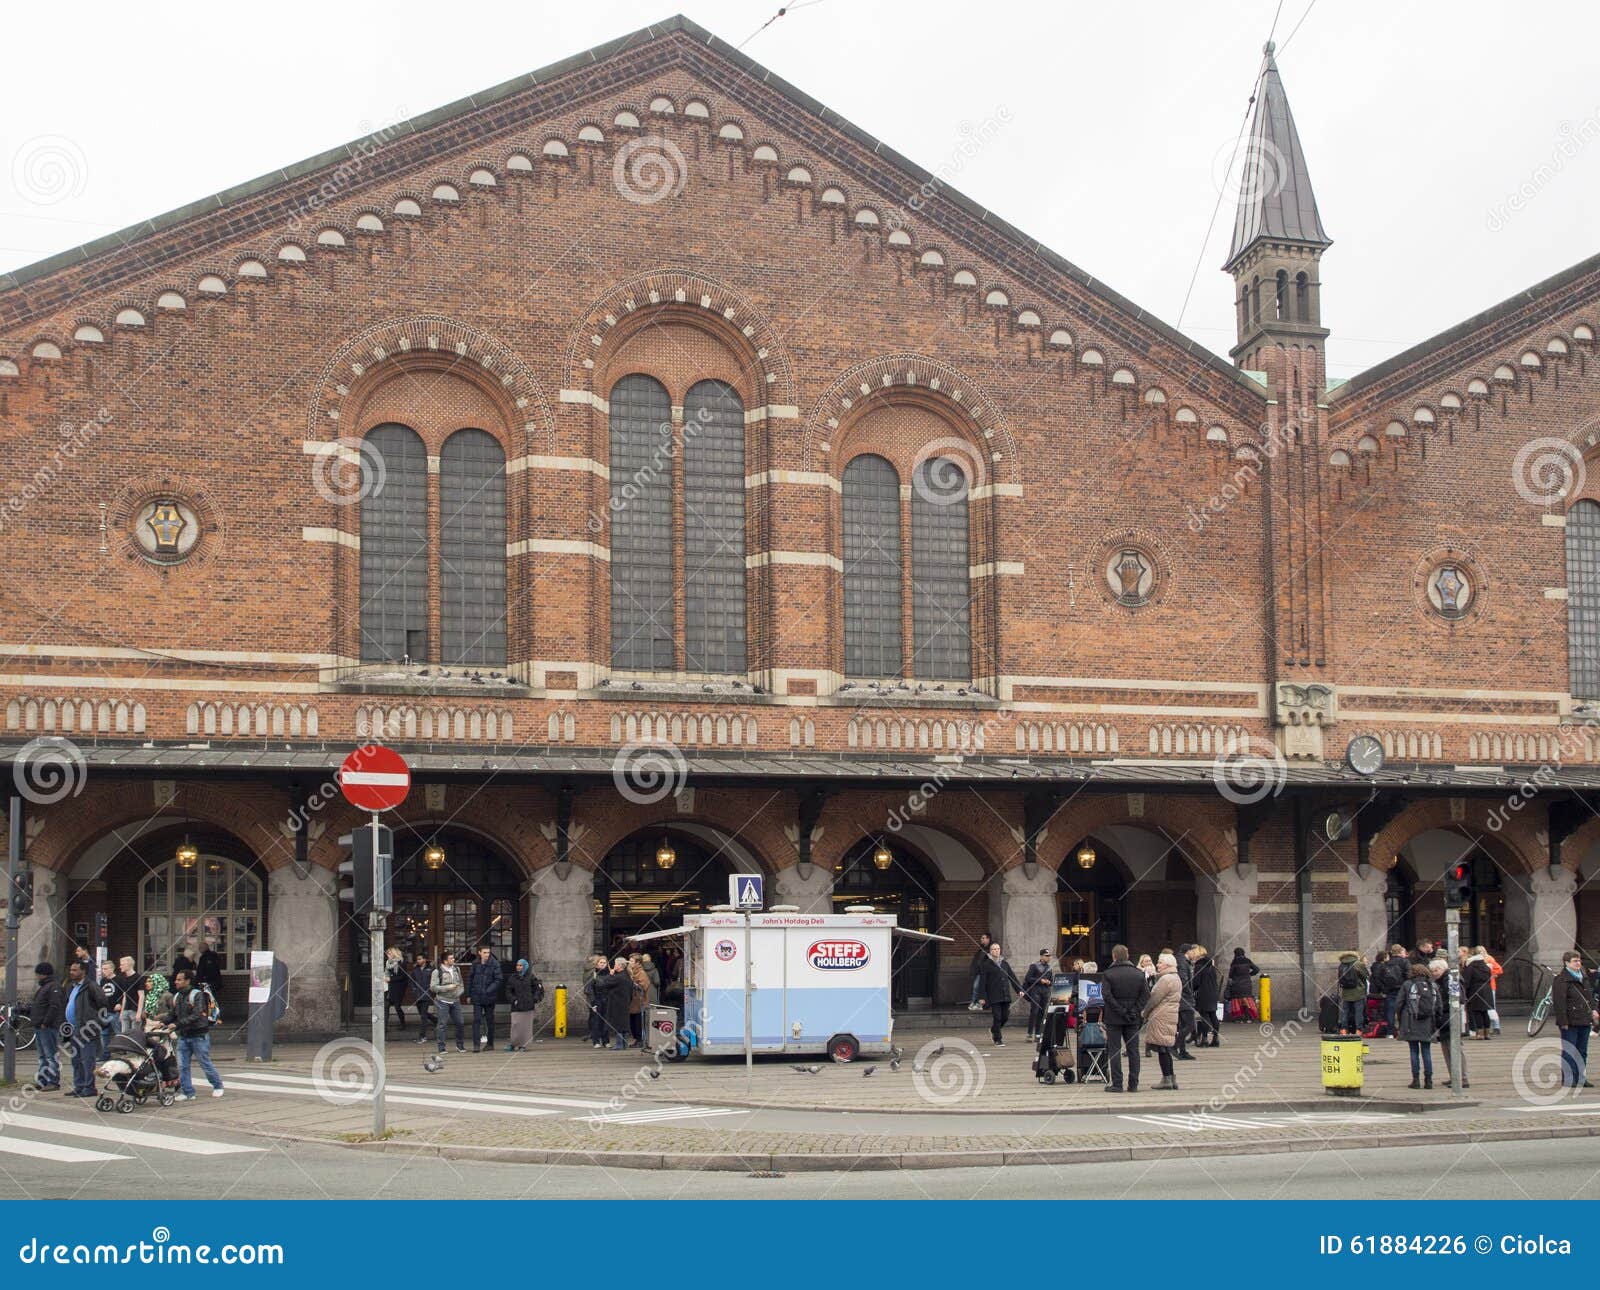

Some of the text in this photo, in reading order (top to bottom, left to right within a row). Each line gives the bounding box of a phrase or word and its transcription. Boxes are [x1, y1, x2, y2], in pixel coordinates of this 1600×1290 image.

[784, 918, 810, 927] Hotdog
[817, 943, 862, 957] STEFF
[817, 957, 862, 967] HOULBERG
[1322, 1055, 1340, 1063] REN
[1322, 1065, 1340, 1073] KBH
